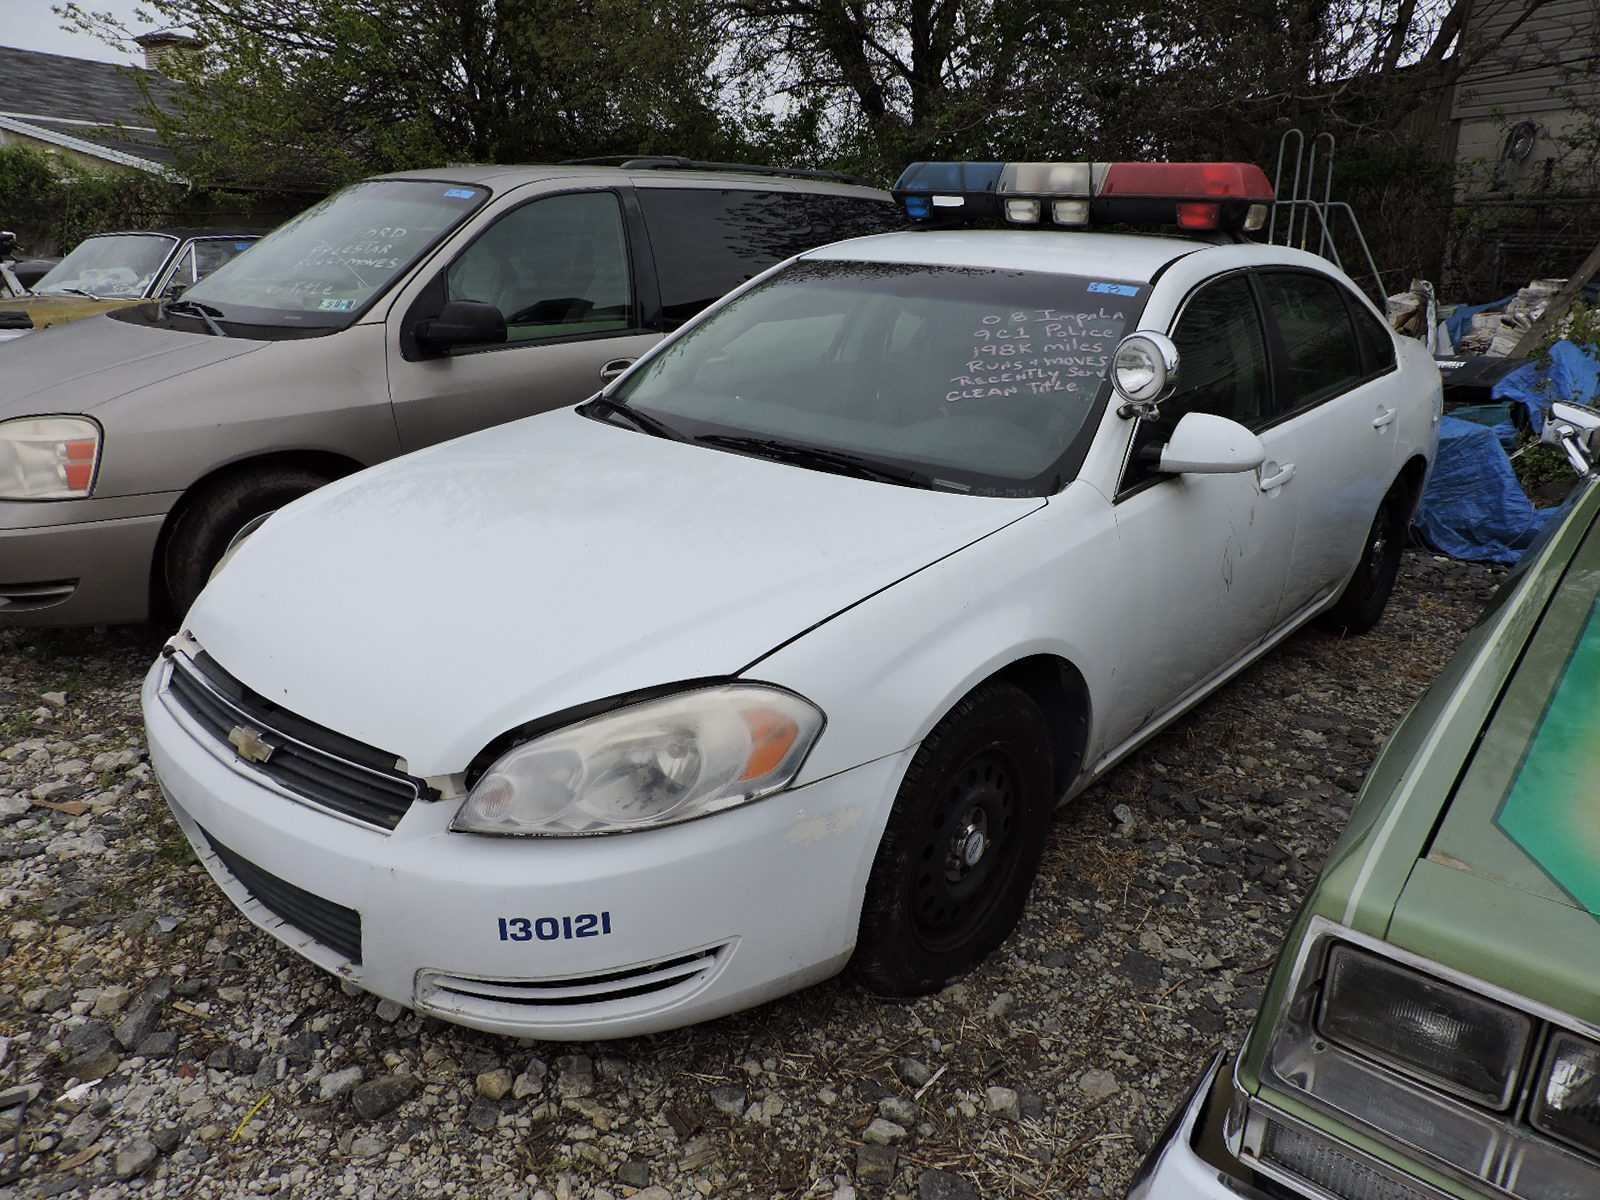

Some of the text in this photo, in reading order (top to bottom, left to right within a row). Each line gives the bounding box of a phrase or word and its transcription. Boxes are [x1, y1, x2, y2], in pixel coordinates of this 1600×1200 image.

[1043, 337, 1104, 353] miles
[950, 367, 1061, 386] RECENTLY
[944, 385, 1019, 402] CLEAN
[498, 911, 612, 942] 130121
